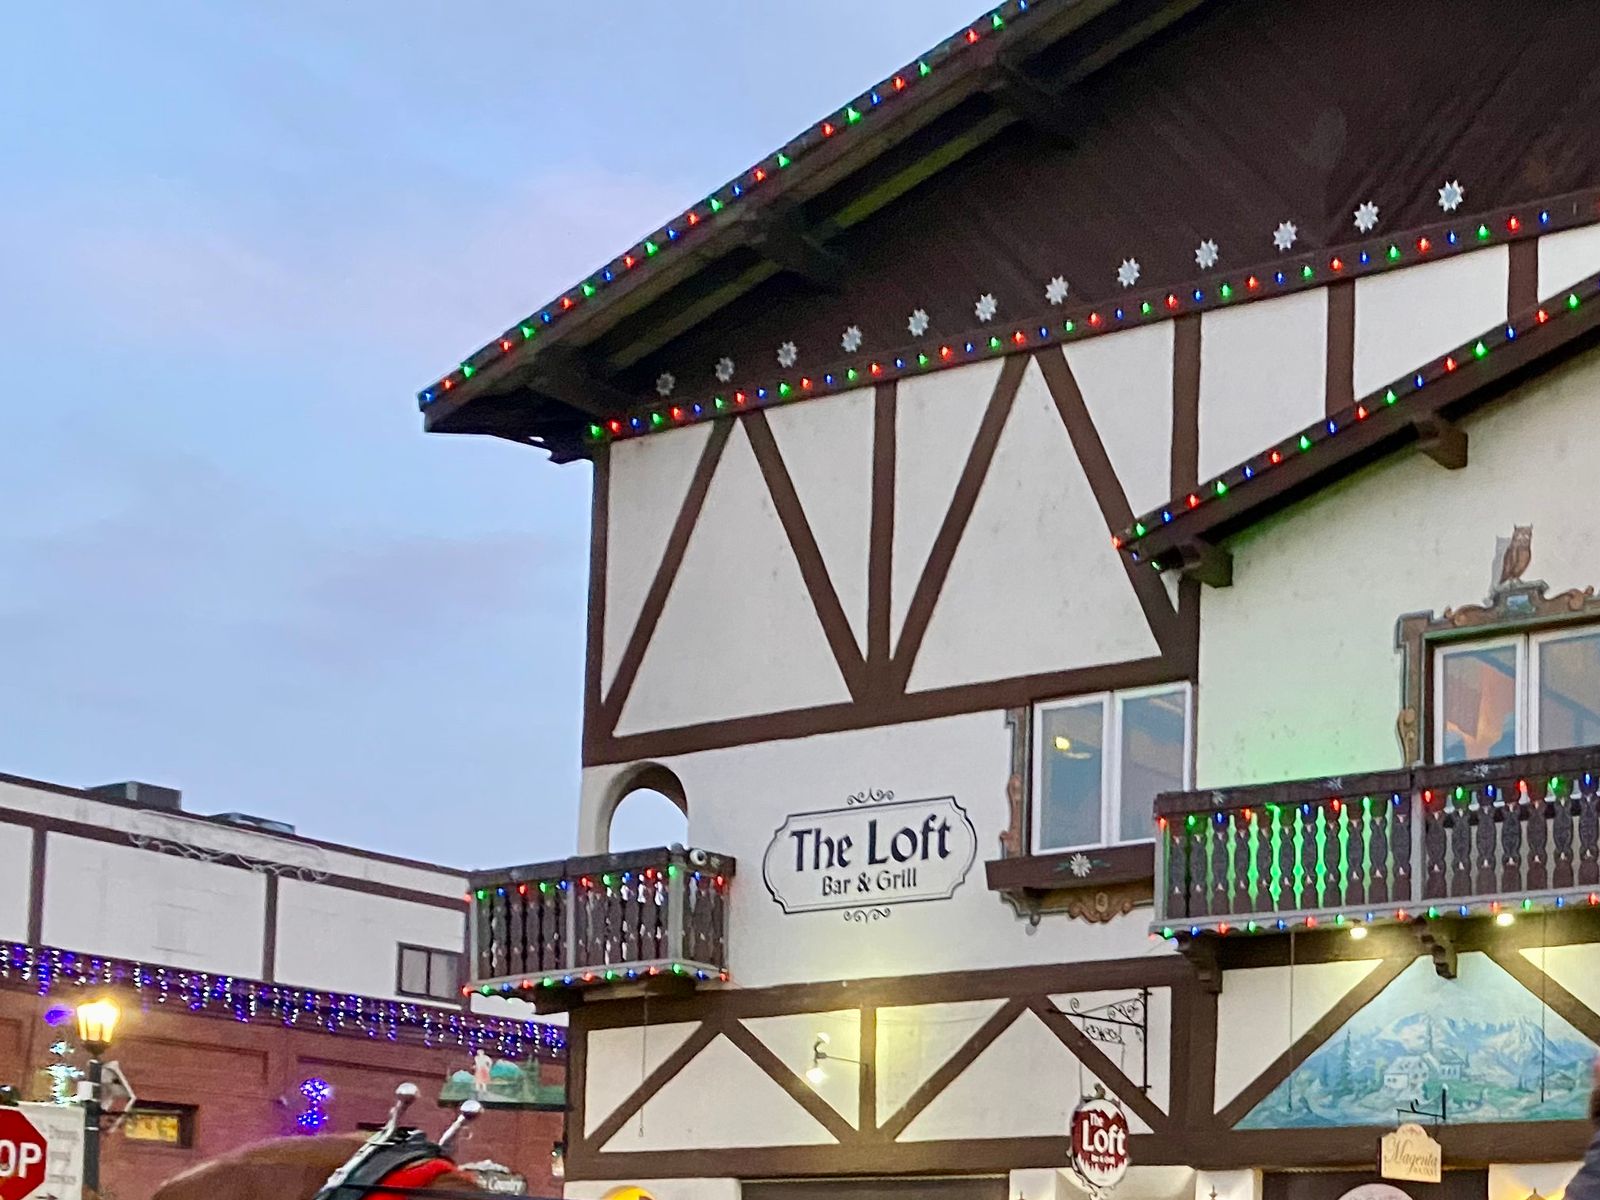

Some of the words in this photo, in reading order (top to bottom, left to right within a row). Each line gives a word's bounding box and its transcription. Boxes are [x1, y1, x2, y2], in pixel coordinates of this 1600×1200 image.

[788, 827, 854, 872] The
[867, 813, 951, 866] Loft
[821, 876, 851, 896] Bar
[856, 871, 872, 893] &
[876, 867, 917, 890] Grill
[1082, 1119, 1126, 1157] Loft
[1385, 1137, 1438, 1175] Magenta
